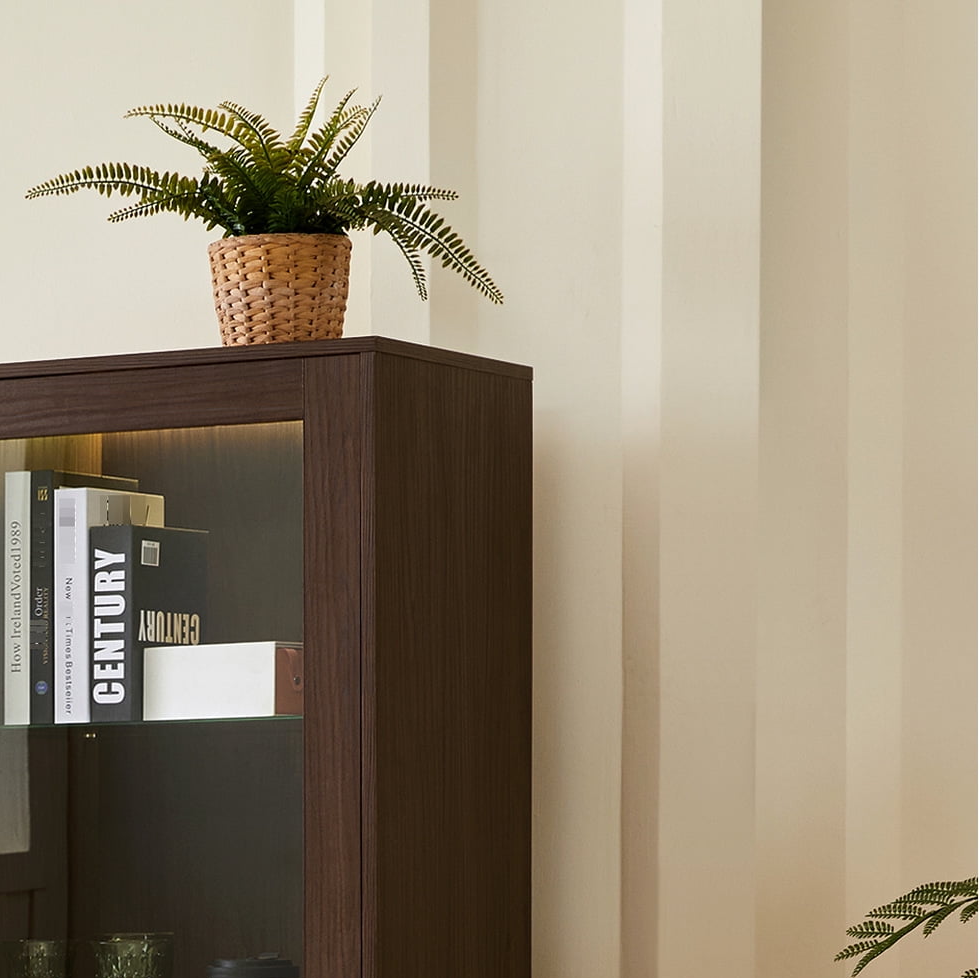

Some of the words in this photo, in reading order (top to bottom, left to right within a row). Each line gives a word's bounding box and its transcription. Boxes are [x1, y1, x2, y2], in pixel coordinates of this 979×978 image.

[34, 586, 43, 618] Order
[65, 577, 74, 600] New
[92, 548, 126, 705] CENTURY
[138, 609, 201, 646] CENTURY
[10, 643, 22, 674] How
[64, 628, 74, 660] Times
